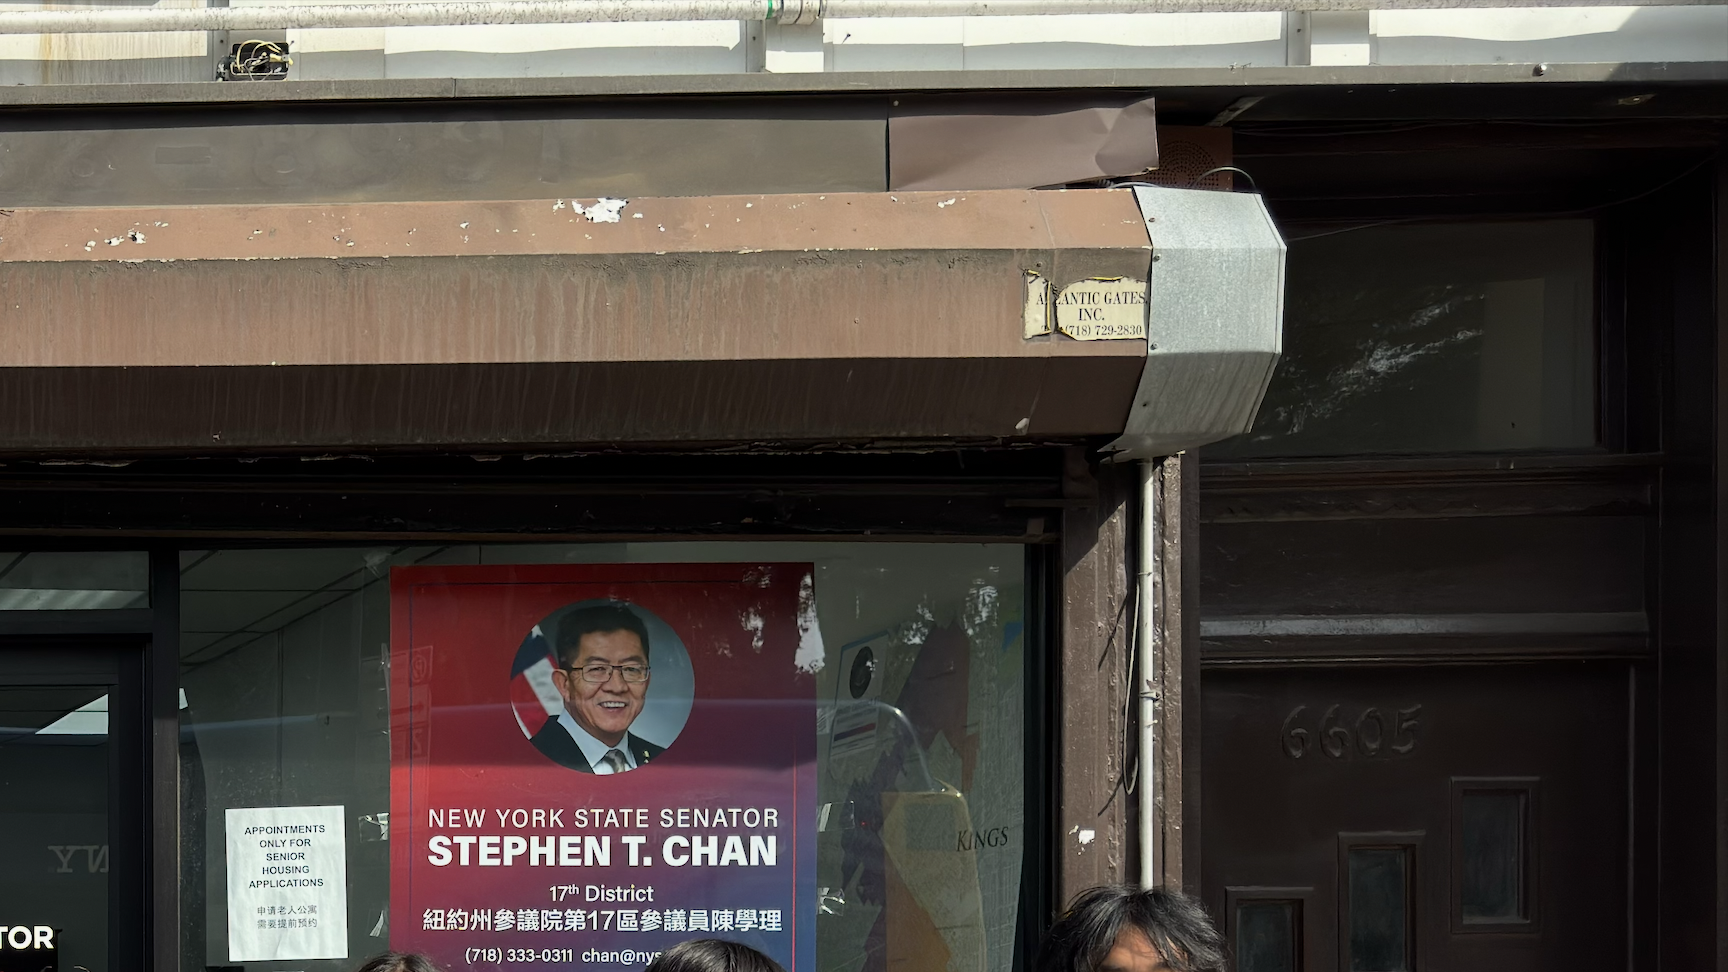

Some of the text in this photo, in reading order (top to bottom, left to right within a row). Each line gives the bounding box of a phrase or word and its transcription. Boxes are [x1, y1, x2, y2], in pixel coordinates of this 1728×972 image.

[1078, 308, 1105, 321] INC.
[1095, 325, 1142, 336] 729-2830
[1280, 704, 1422, 759] 6605
[427, 808, 779, 828] NEW YORK STATE SENATOR
[244, 824, 326, 835] APPOINTMENTS
[259, 838, 312, 848] ONLY FOR
[956, 826, 1009, 852] KINGS
[266, 852, 306, 862] SENIOR
[427, 836, 777, 867] STEPHEN T. CHAN
[262, 865, 310, 875] HOUSING
[248, 878, 324, 889] APPLICATIONS
[549, 884, 654, 902] 17th District
[257, 904, 318, 917] 申请老人公寓
[257, 918, 318, 930] 需要提前预约
[422, 908, 783, 933] 紐約州參議院第17區參議員陳學理
[465, 947, 503, 965] (718)
[506, 947, 573, 963] 333-0311
